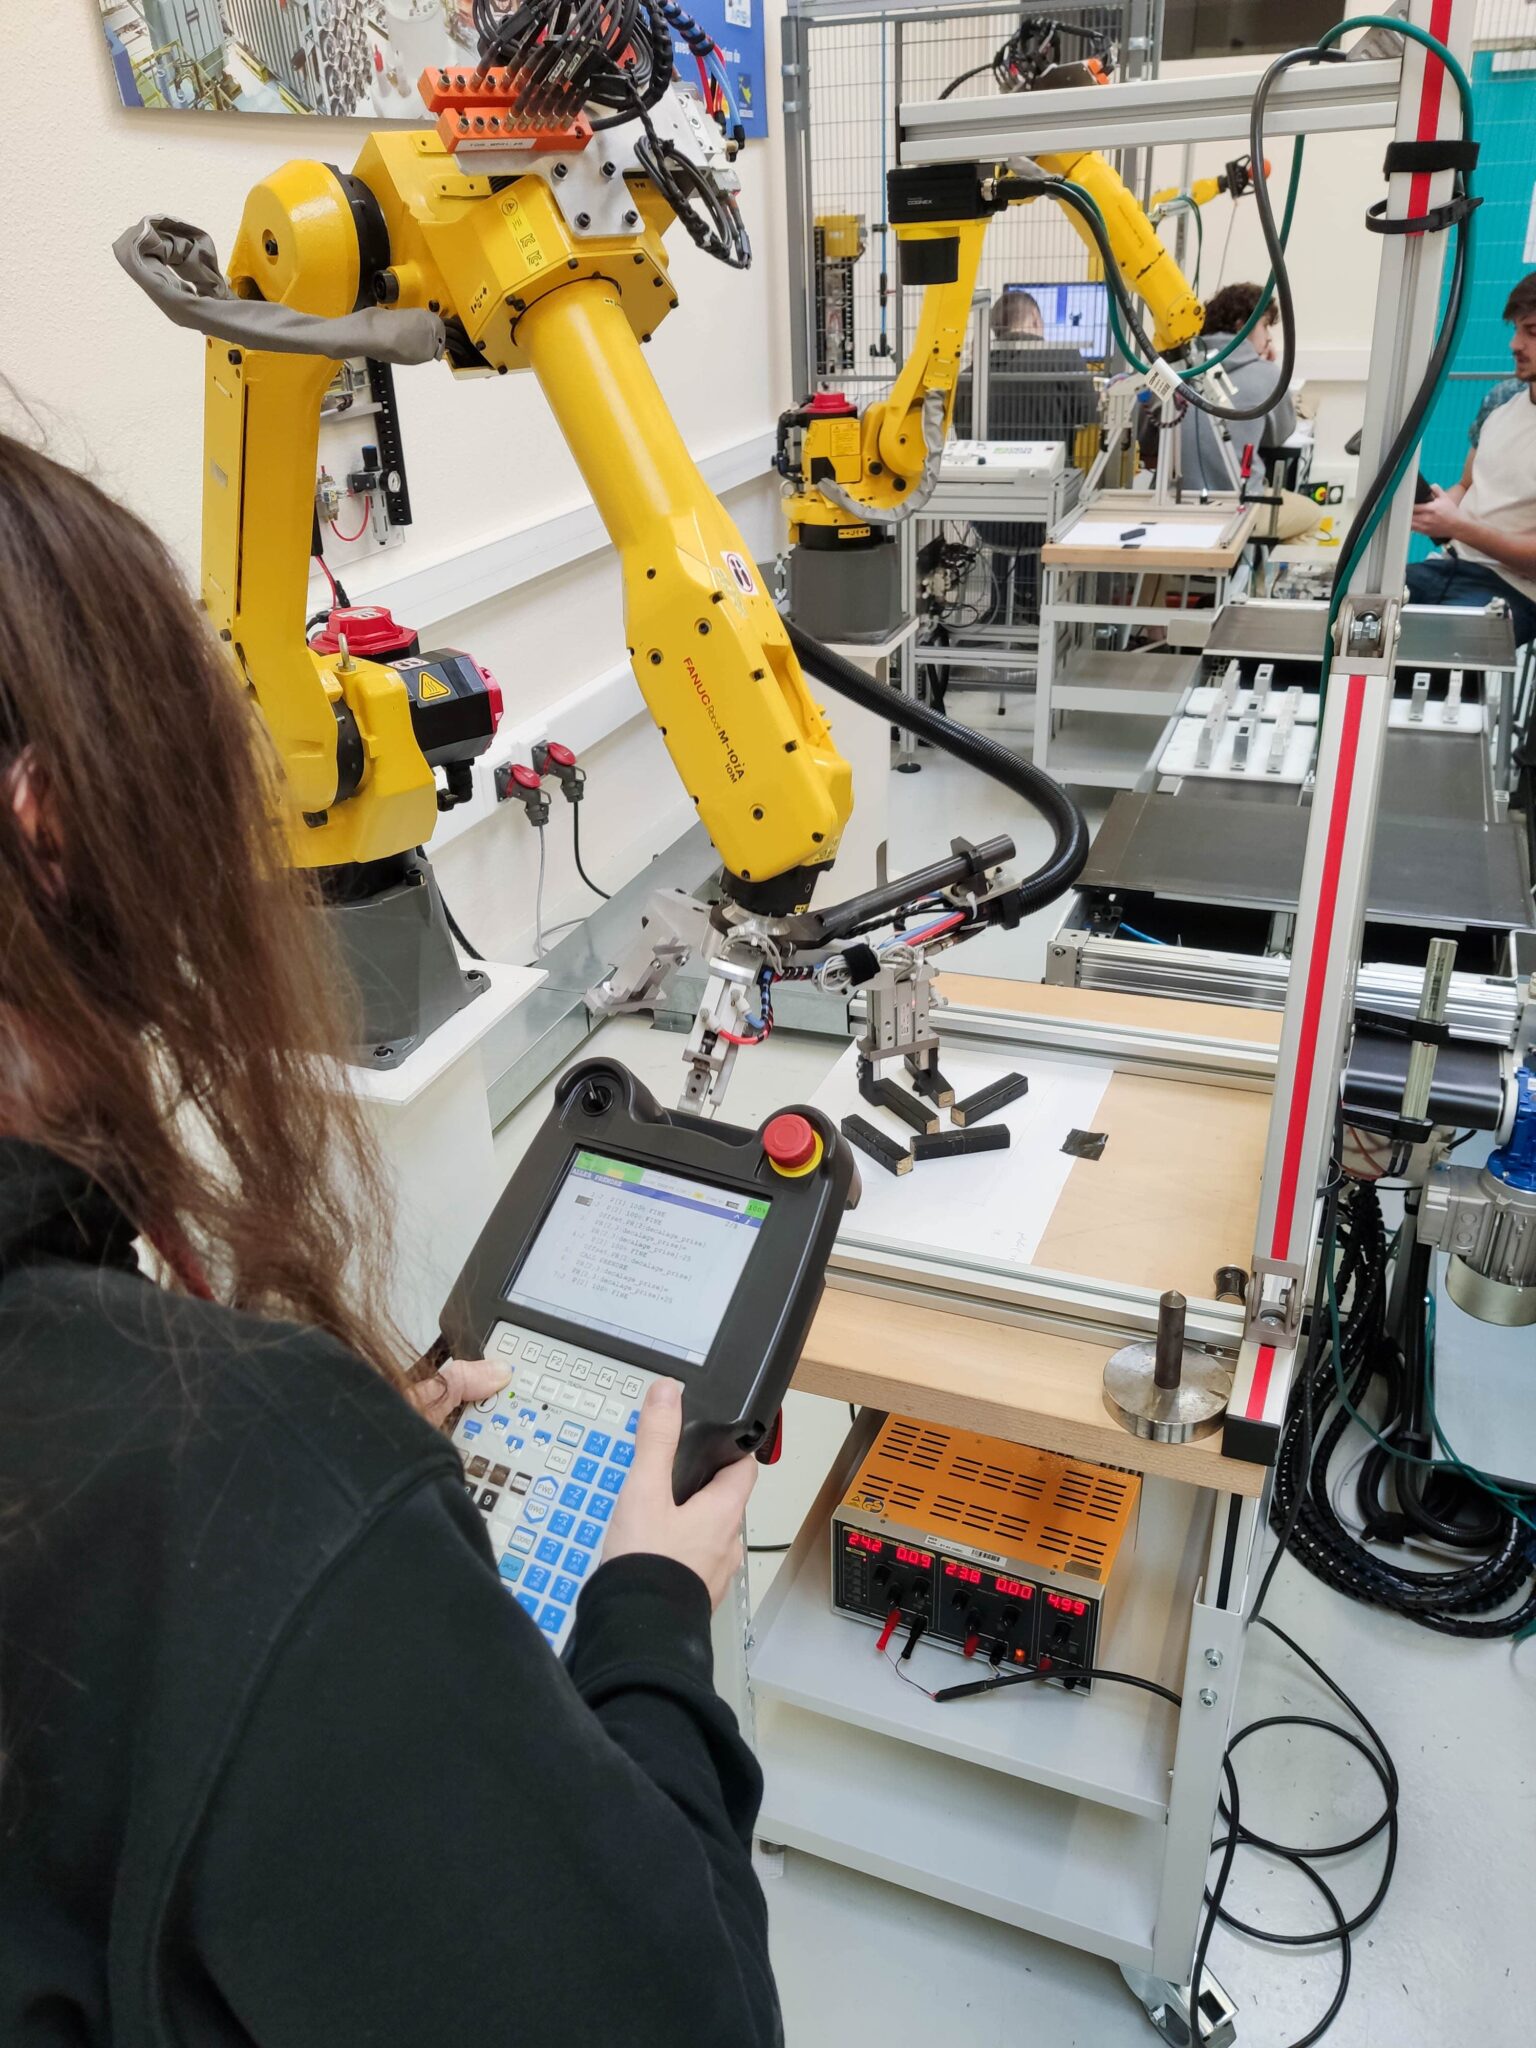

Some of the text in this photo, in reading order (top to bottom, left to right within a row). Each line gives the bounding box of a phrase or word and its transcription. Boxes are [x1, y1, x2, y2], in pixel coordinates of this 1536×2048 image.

[683, 657, 711, 706] FANUC
[725, 762, 738, 784] 10M
[526, 1346, 537, 1357] F1
[549, 1355, 562, 1366] F2
[574, 1363, 587, 1374] F3
[600, 1372, 612, 1383] F4
[625, 1381, 638, 1392] F5
[562, 1428, 578, 1439] STEP
[591, 1433, 606, 1446] -X
[617, 1443, 631, 1455] +X
[550, 1454, 566, 1465] HOLD
[579, 1459, 593, 1472] -Y
[606, 1470, 620, 1482] +Y
[537, 1484, 553, 1495] FWD
[567, 1486, 582, 1499] -Z
[482, 1493, 492, 1506] 9
[1047, 1593, 1086, 1616] 4.99
